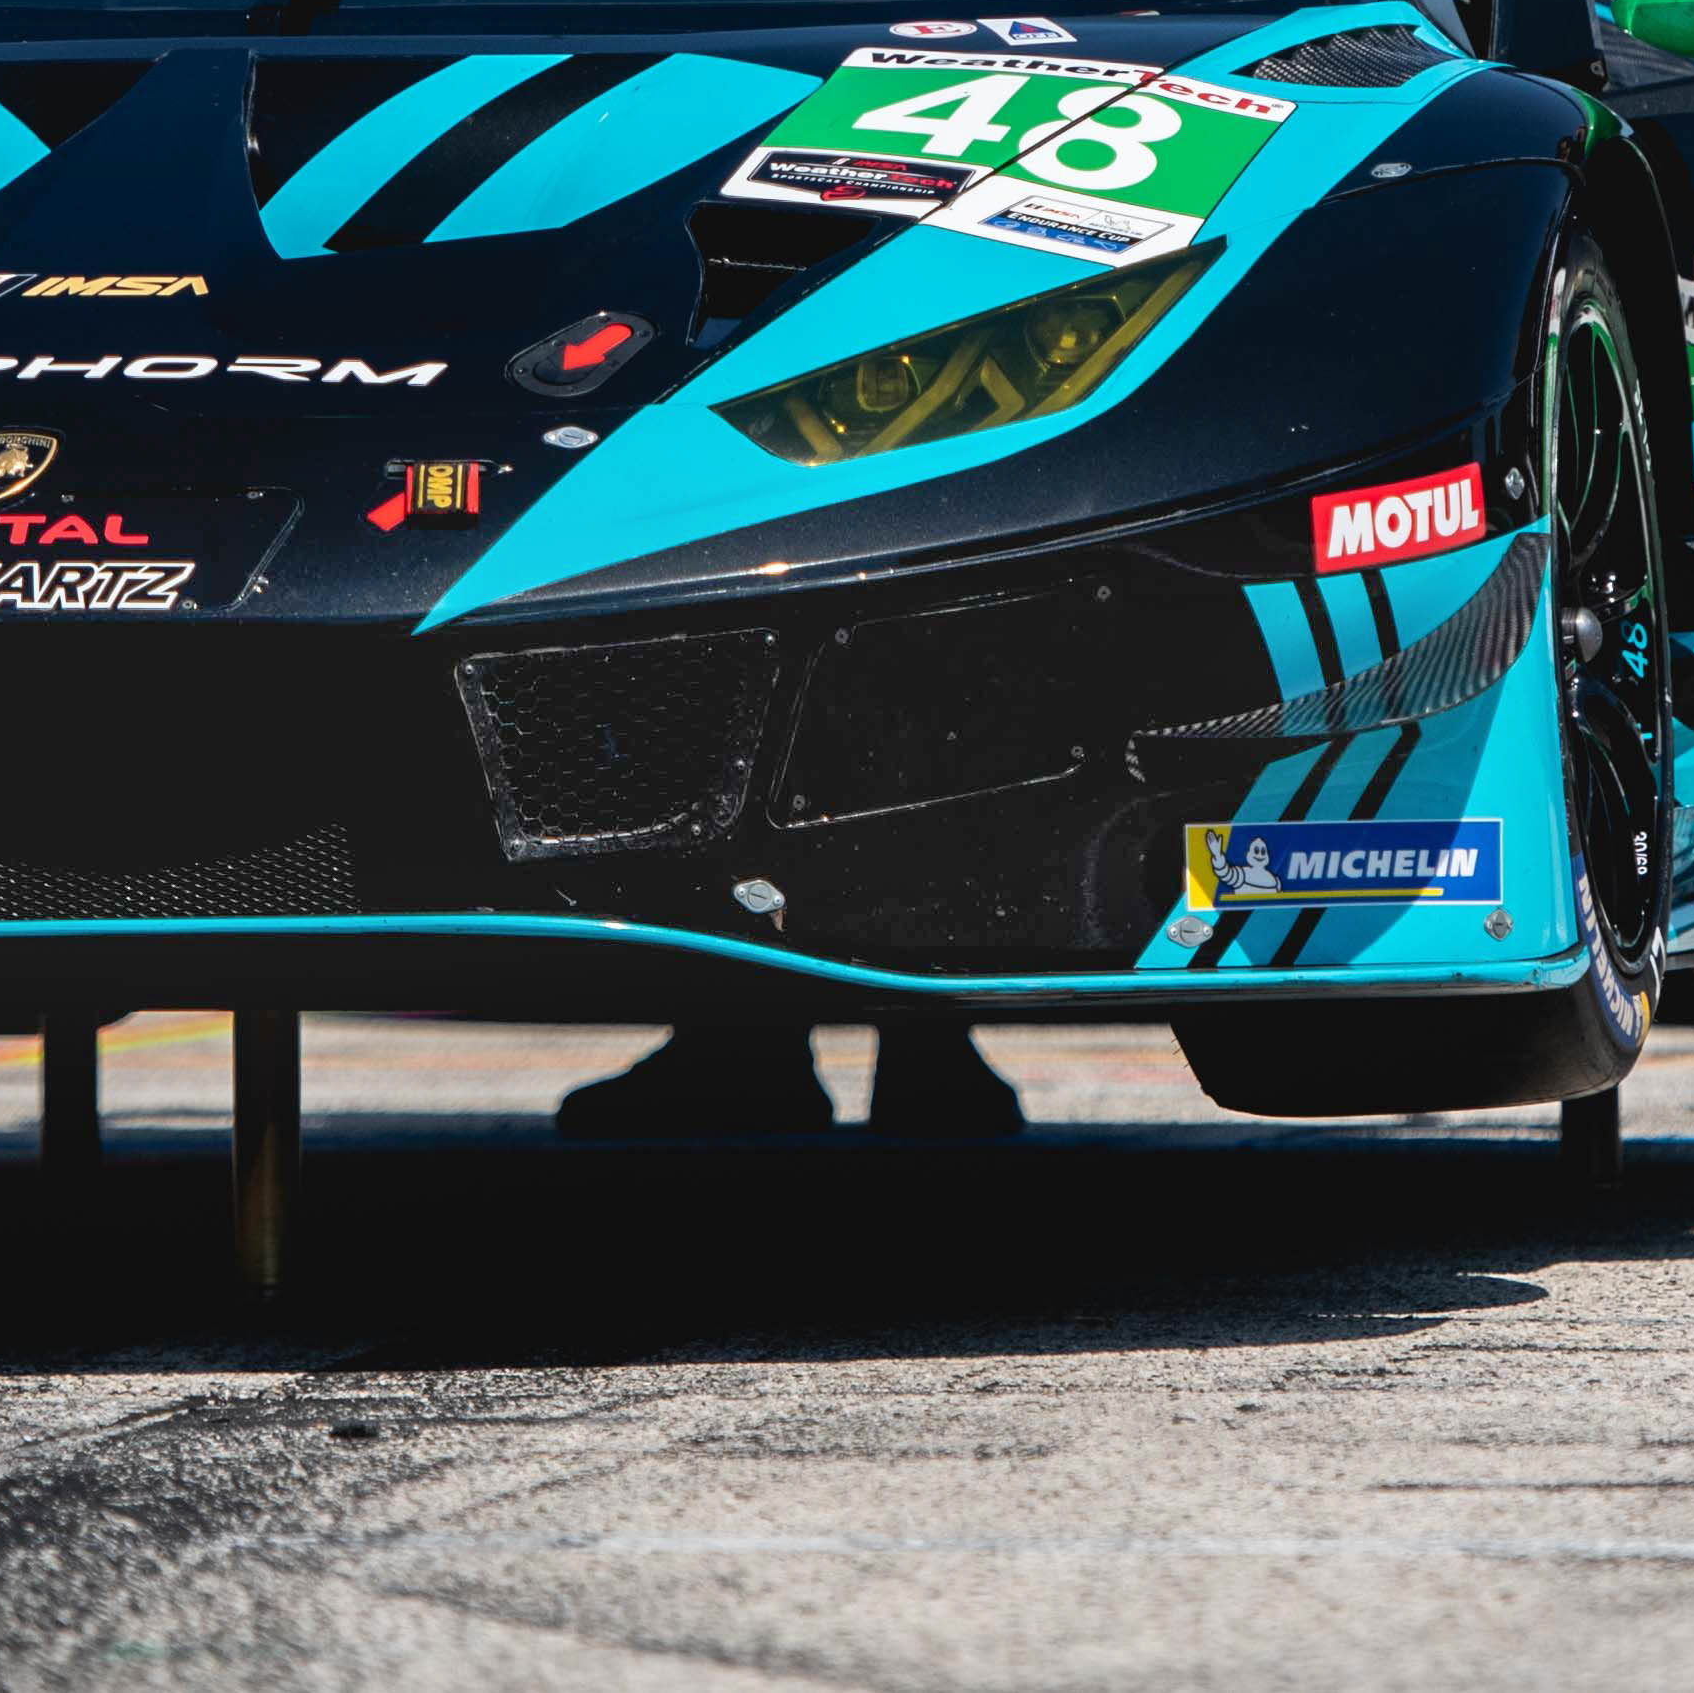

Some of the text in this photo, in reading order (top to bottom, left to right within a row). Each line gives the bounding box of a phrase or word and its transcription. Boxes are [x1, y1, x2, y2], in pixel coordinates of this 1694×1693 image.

[851, 73, 1183, 191] 48
[21, 275, 210, 298] IMSA
[427, 466, 454, 508] OMP
[1327, 478, 1480, 559] MOTUL
[1287, 848, 1479, 880] MICHELIN
[1578, 873, 1635, 1037] MICHELIN
